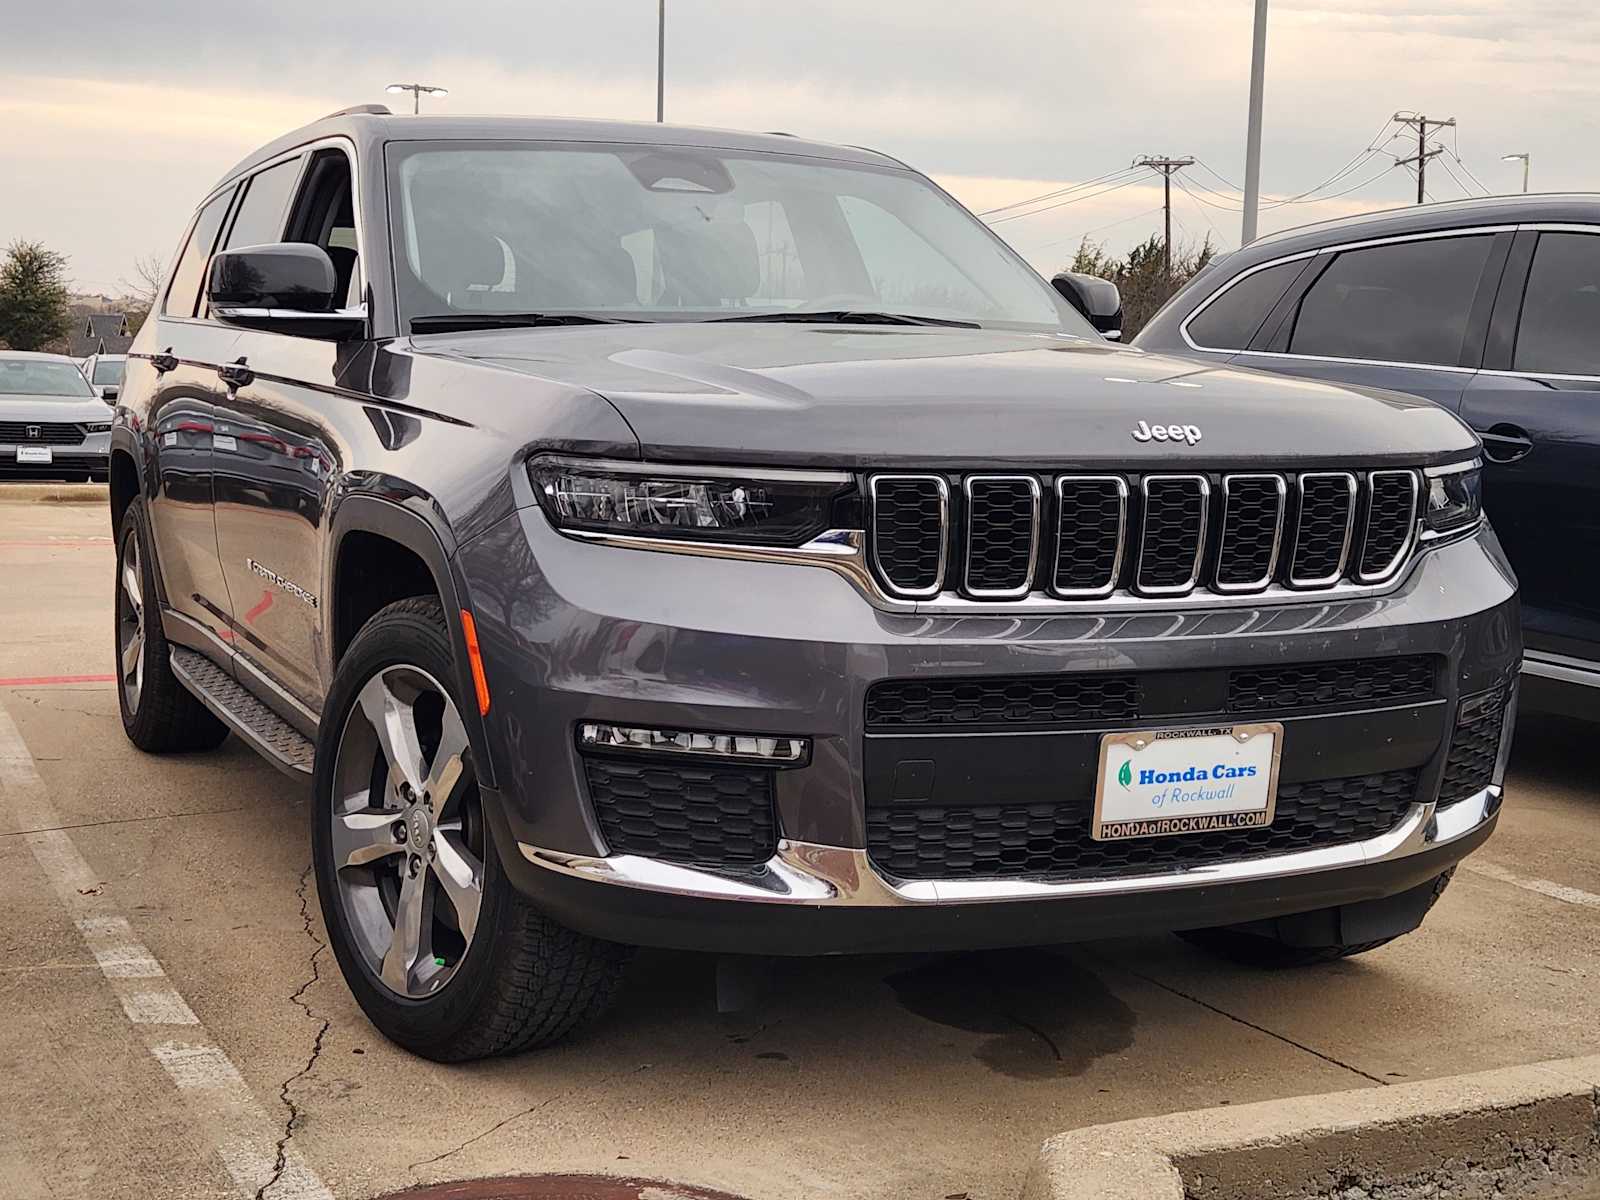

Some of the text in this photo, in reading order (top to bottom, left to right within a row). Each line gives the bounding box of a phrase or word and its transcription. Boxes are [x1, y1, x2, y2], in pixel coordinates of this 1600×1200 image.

[1131, 420, 1202, 446] Jeep
[1220, 728, 1232, 736] TX
[1139, 764, 1257, 784] Honda Cars
[1152, 784, 1234, 808] of Rockwall
